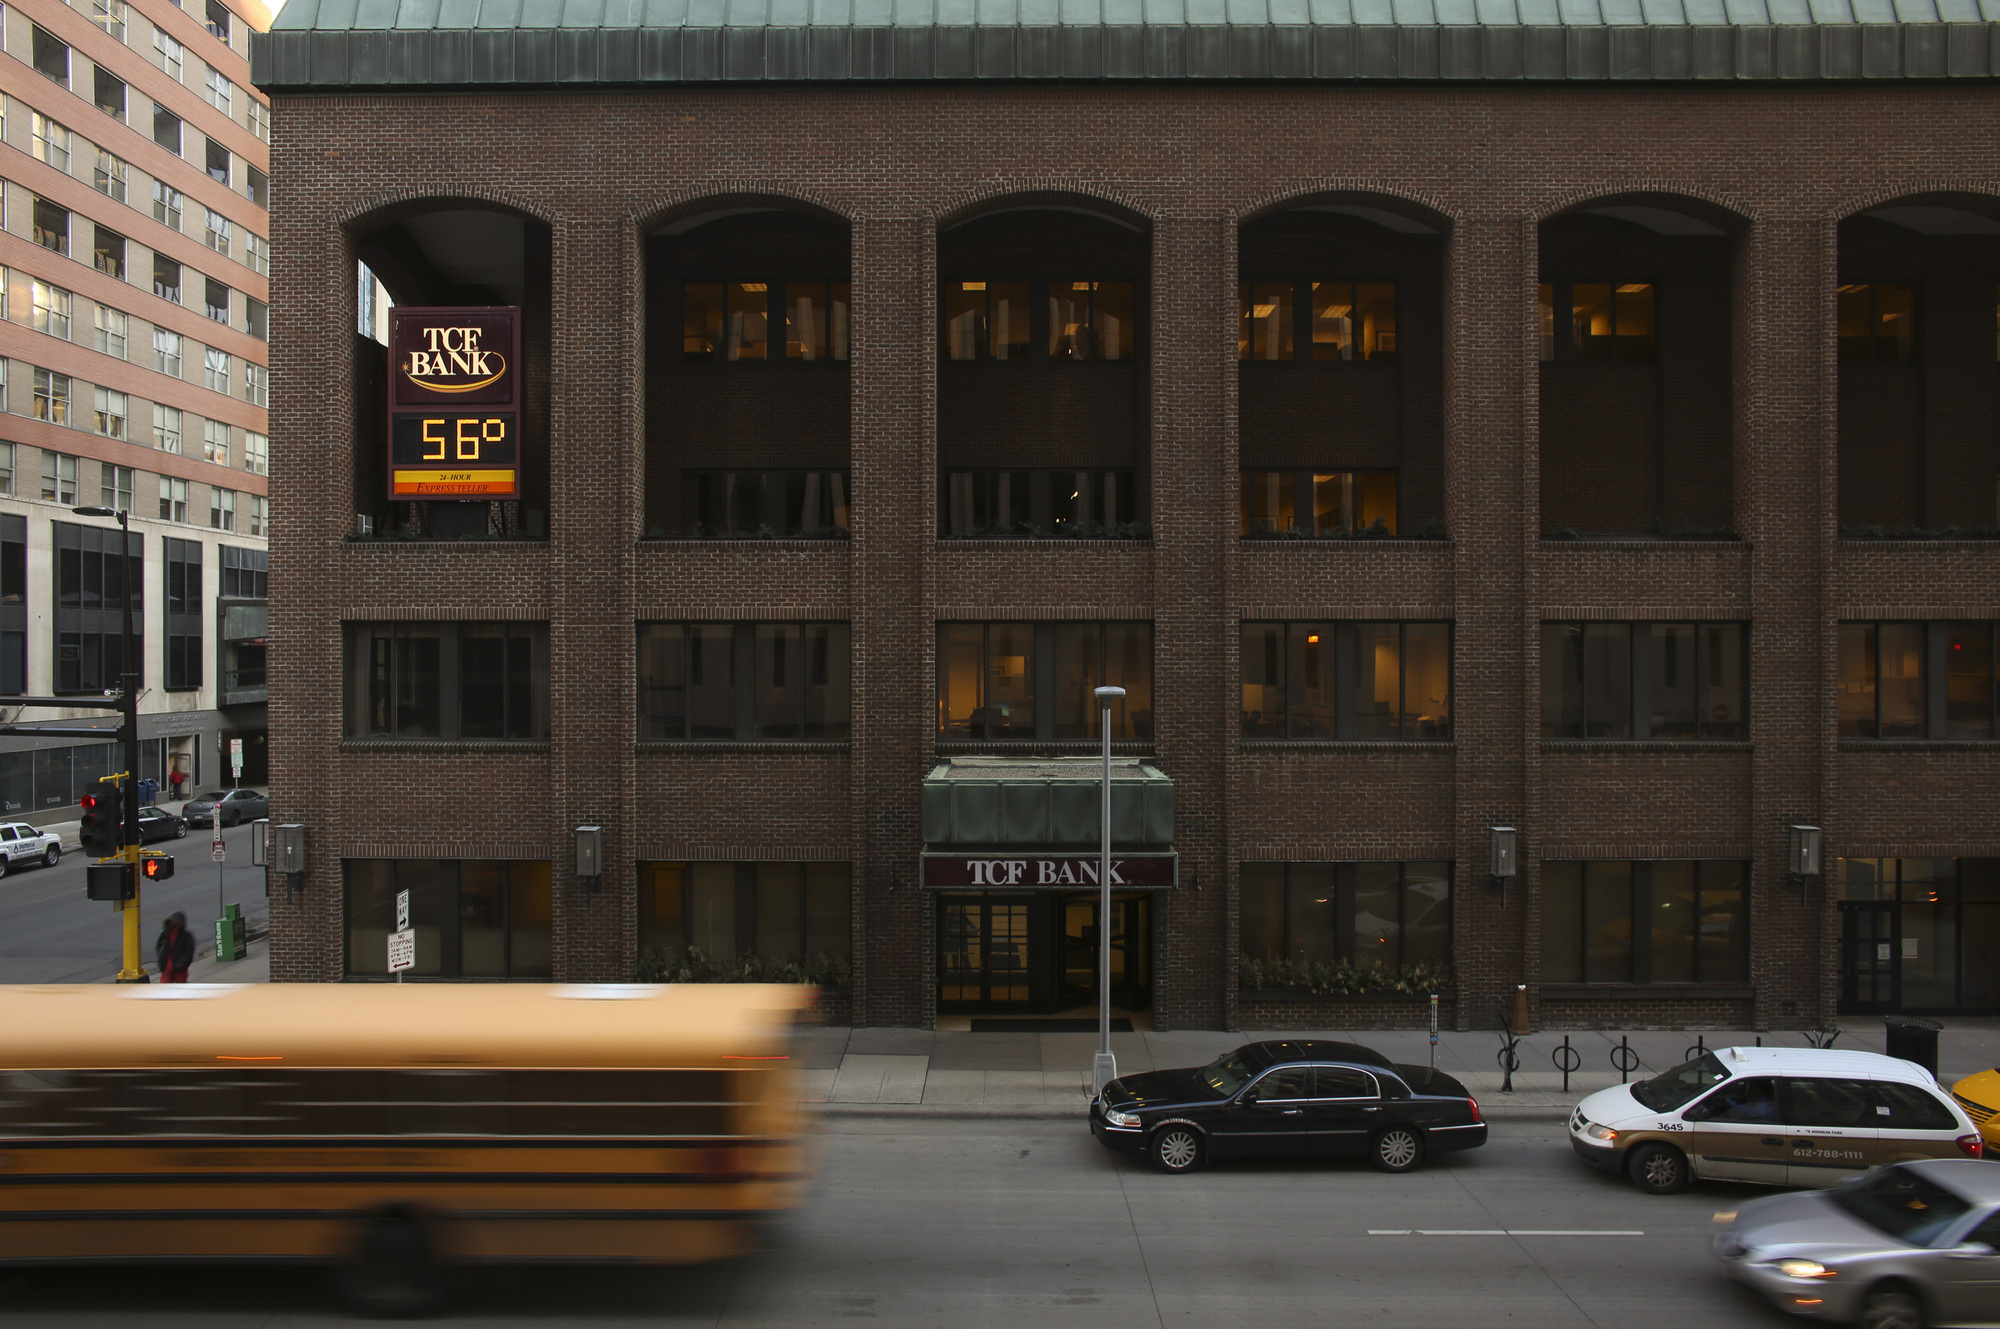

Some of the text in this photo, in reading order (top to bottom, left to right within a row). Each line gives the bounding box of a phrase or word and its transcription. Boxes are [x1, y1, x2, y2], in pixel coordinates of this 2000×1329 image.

[423, 327, 482, 352] TCF
[409, 351, 493, 376] BANK
[457, 484, 488, 492] TELLER
[967, 860, 1127, 886] TCF BANK
[390, 938, 413, 948] STOPPING
[1657, 1122, 1684, 1131] 3645
[1793, 1148, 1863, 1160] 612-788-1111
